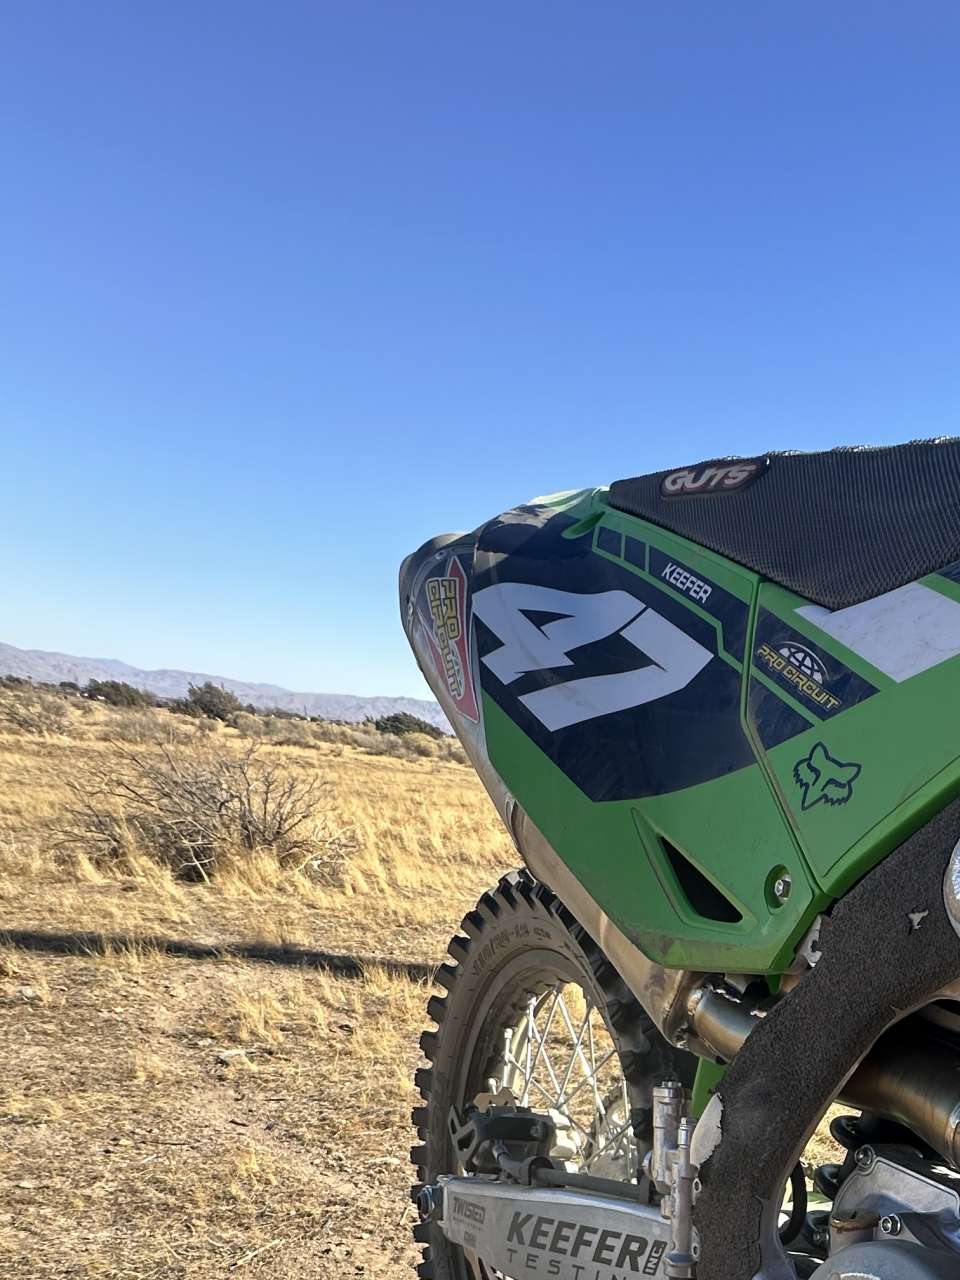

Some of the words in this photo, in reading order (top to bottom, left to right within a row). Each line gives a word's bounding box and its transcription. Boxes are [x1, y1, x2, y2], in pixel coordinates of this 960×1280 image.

[665, 464, 757, 491] GUTS
[441, 579, 460, 640] PRO
[661, 562, 712, 604] KEEFER
[428, 579, 462, 698] CIRCUIT
[472, 583, 714, 732] 47
[757, 645, 785, 667] PRO
[783, 665, 839, 709] CIRCUIT
[506, 1210, 649, 1273] KEEFER
